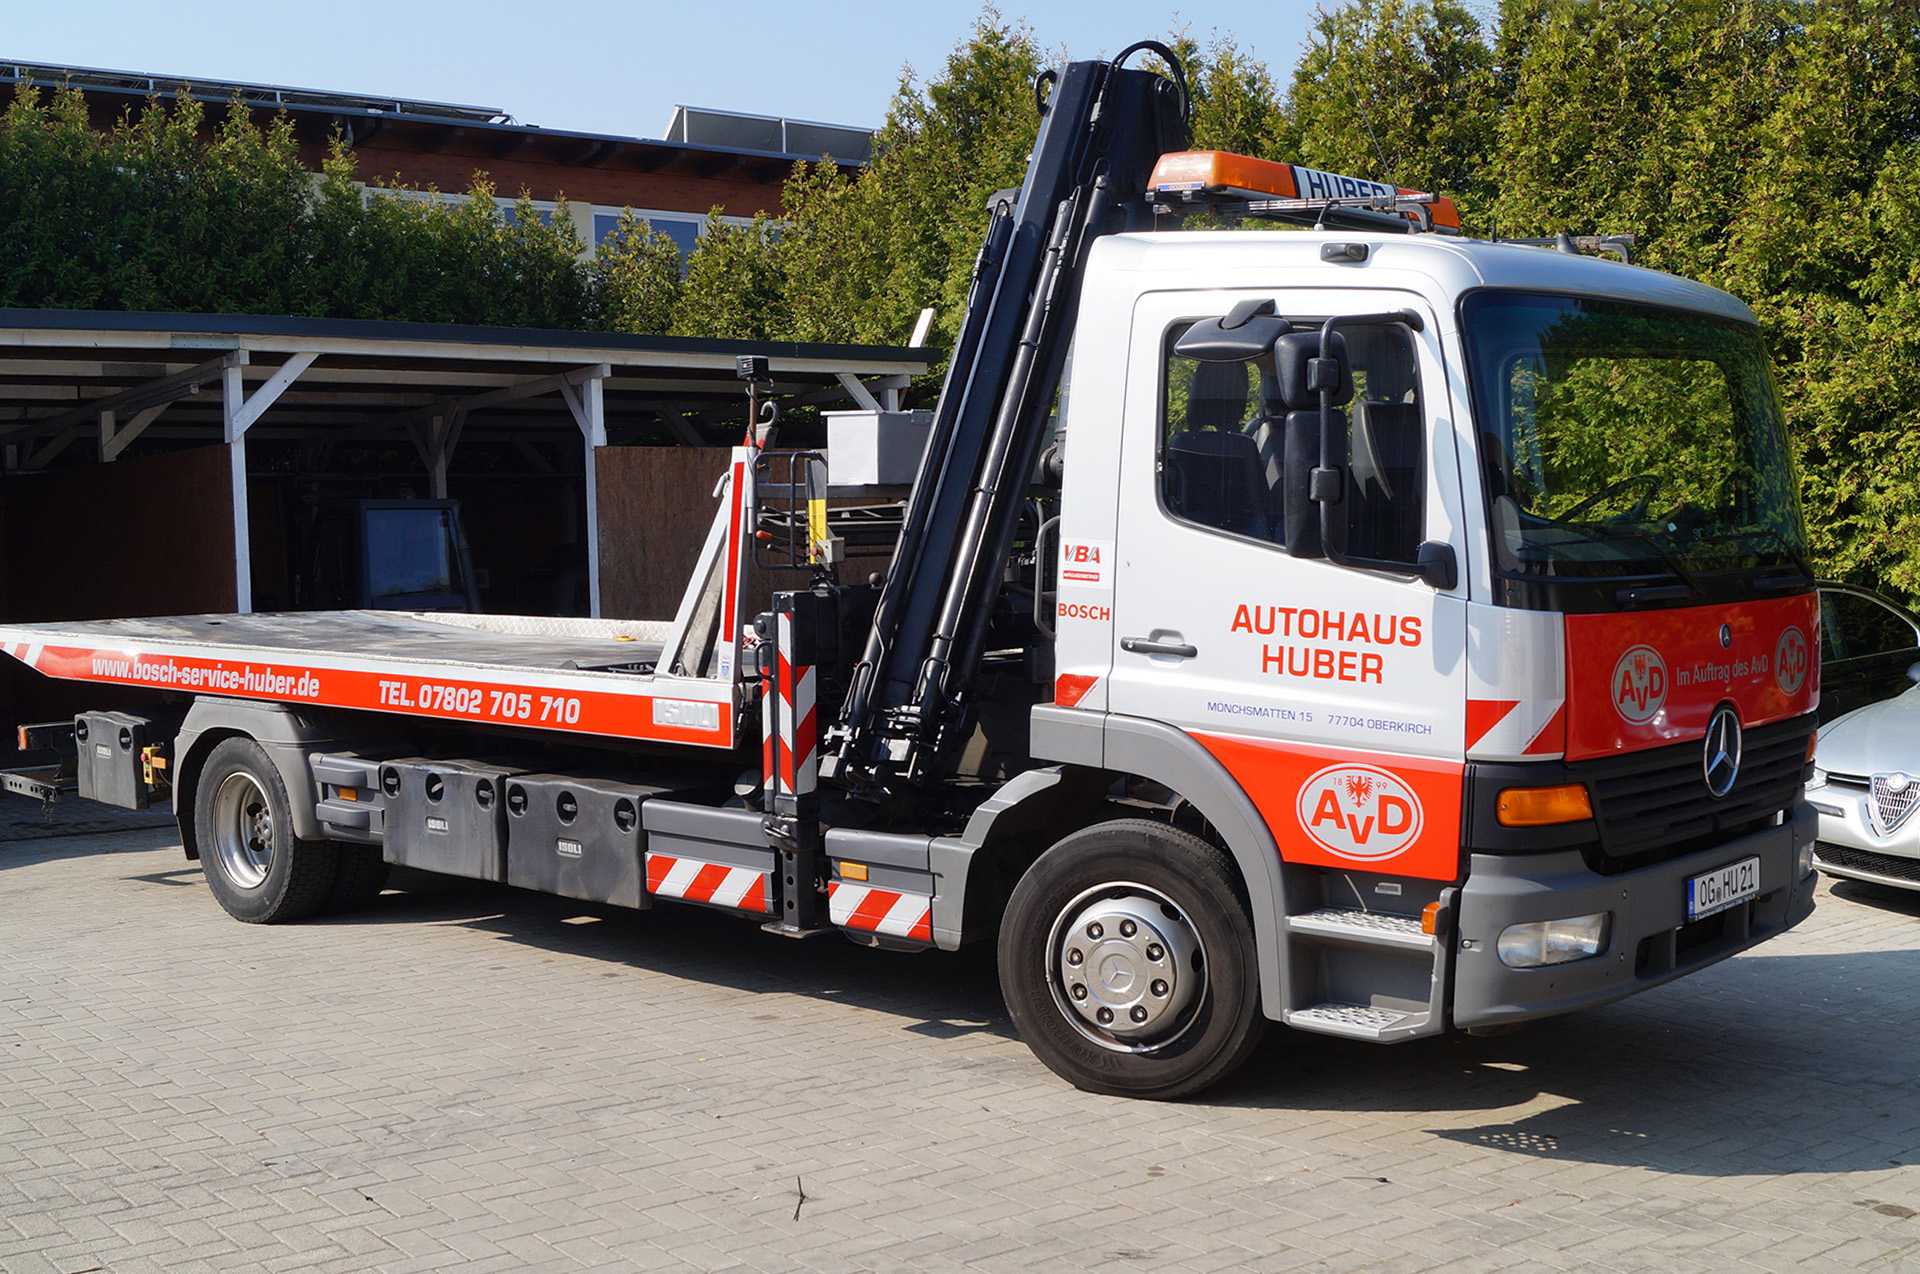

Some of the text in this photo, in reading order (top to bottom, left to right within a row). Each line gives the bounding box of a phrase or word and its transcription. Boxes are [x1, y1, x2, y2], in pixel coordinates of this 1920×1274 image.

[1064, 544, 1101, 564] VBA
[1058, 603, 1110, 621] BOSCH
[1231, 604, 1422, 647] AUTOHAUS
[92, 657, 320, 698] www.bosch-service-huber.de
[1262, 644, 1383, 684] HUBER
[1676, 654, 1769, 687] Im Auftrag des AvD
[379, 680, 581, 724] TEL. 07802 705 710
[1299, 711, 1313, 722] 15
[1328, 715, 1364, 728] 77704
[1366, 719, 1432, 735] OBERKIRCH
[1333, 777, 1388, 790] 18 99
[428, 819, 449, 831] ISOLI
[558, 841, 582, 854] ISOLI
[1700, 877, 1715, 907] OG
[1723, 868, 1738, 899] HU
[1740, 863, 1754, 892] 21
